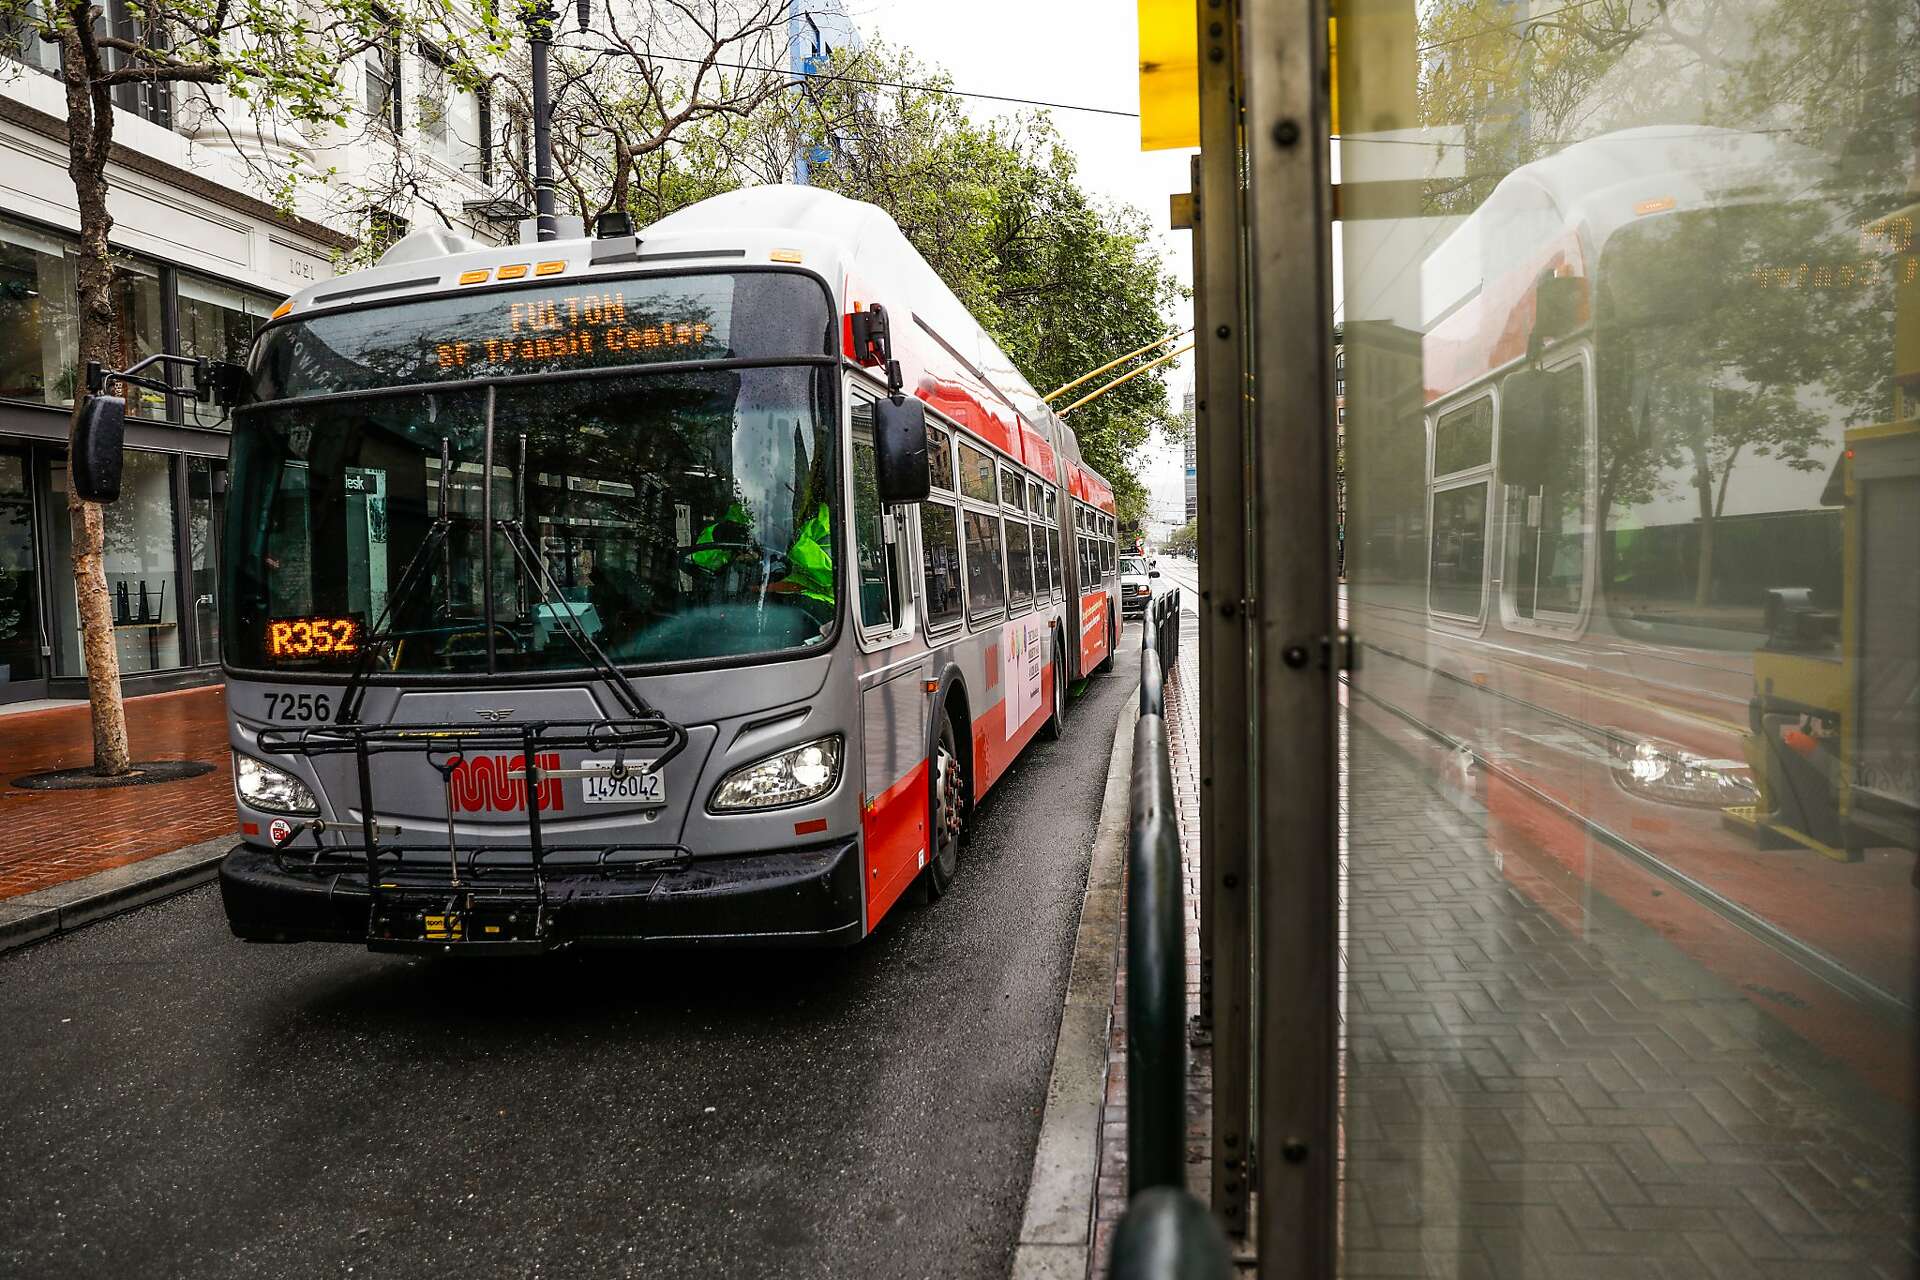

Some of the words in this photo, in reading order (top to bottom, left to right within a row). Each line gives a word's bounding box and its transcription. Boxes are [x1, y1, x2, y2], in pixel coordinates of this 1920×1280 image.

[290, 258, 314, 280] 1021
[511, 292, 625, 333] FULTON
[484, 329, 593, 361] Transit
[606, 322, 712, 351] Center
[271, 620, 355, 654] R352
[264, 693, 330, 722] 7256
[588, 774, 660, 797] 1496042
